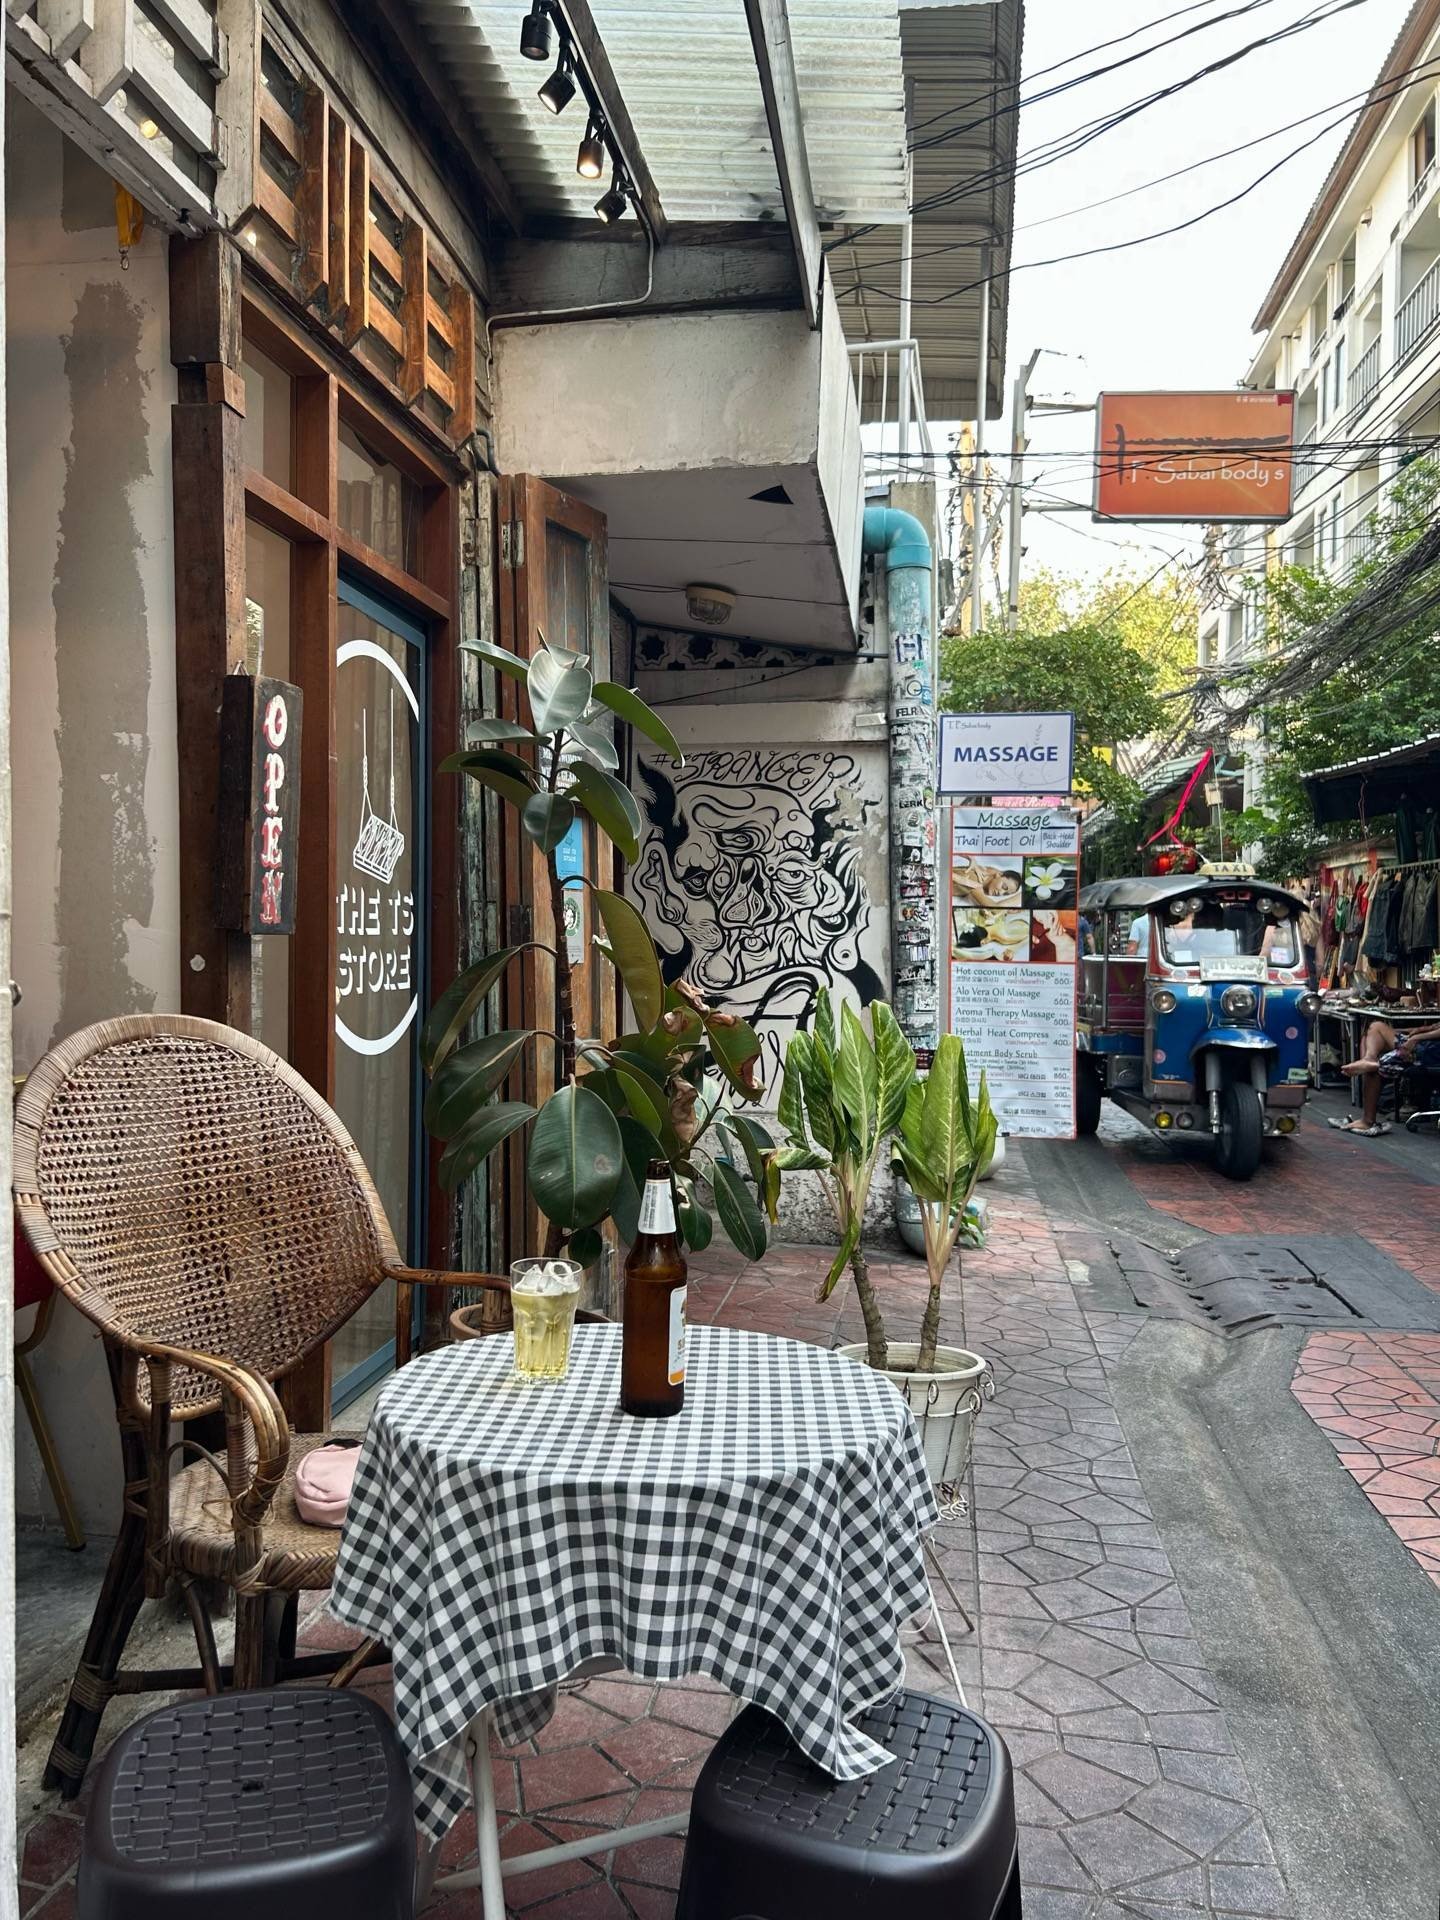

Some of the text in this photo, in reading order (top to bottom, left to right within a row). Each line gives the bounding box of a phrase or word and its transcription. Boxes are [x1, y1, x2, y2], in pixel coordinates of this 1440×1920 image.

[954, 746, 1058, 762] MASSAGE
[259, 694, 289, 925] OPEN
[977, 812, 1051, 831] Massage
[955, 835, 1035, 846] Thai Foot Oil
[1046, 840, 1071, 849] Shoulder
[1213, 864, 1248, 874] TAXI
[336, 883, 381, 936] THE
[339, 945, 411, 997] STORE
[956, 966, 971, 975] Hot
[973, 968, 1006, 977] coconut
[1007, 968, 1018, 977] oil
[1019, 968, 1055, 980] Massage
[956, 986, 970, 996] Alo
[971, 987, 990, 996] Vera
[992, 988, 1005, 996] Oil
[1007, 988, 1041, 1000] Massage
[955, 1007, 983, 1016] Aroma
[985, 1008, 1019, 1020] Therapy
[1021, 1009, 1056, 1020] Massage
[955, 1027, 1049, 1041] Herbal Heat Compress
[994, 1049, 1013, 1059] Body
[1016, 1050, 1038, 1059] Scrub
